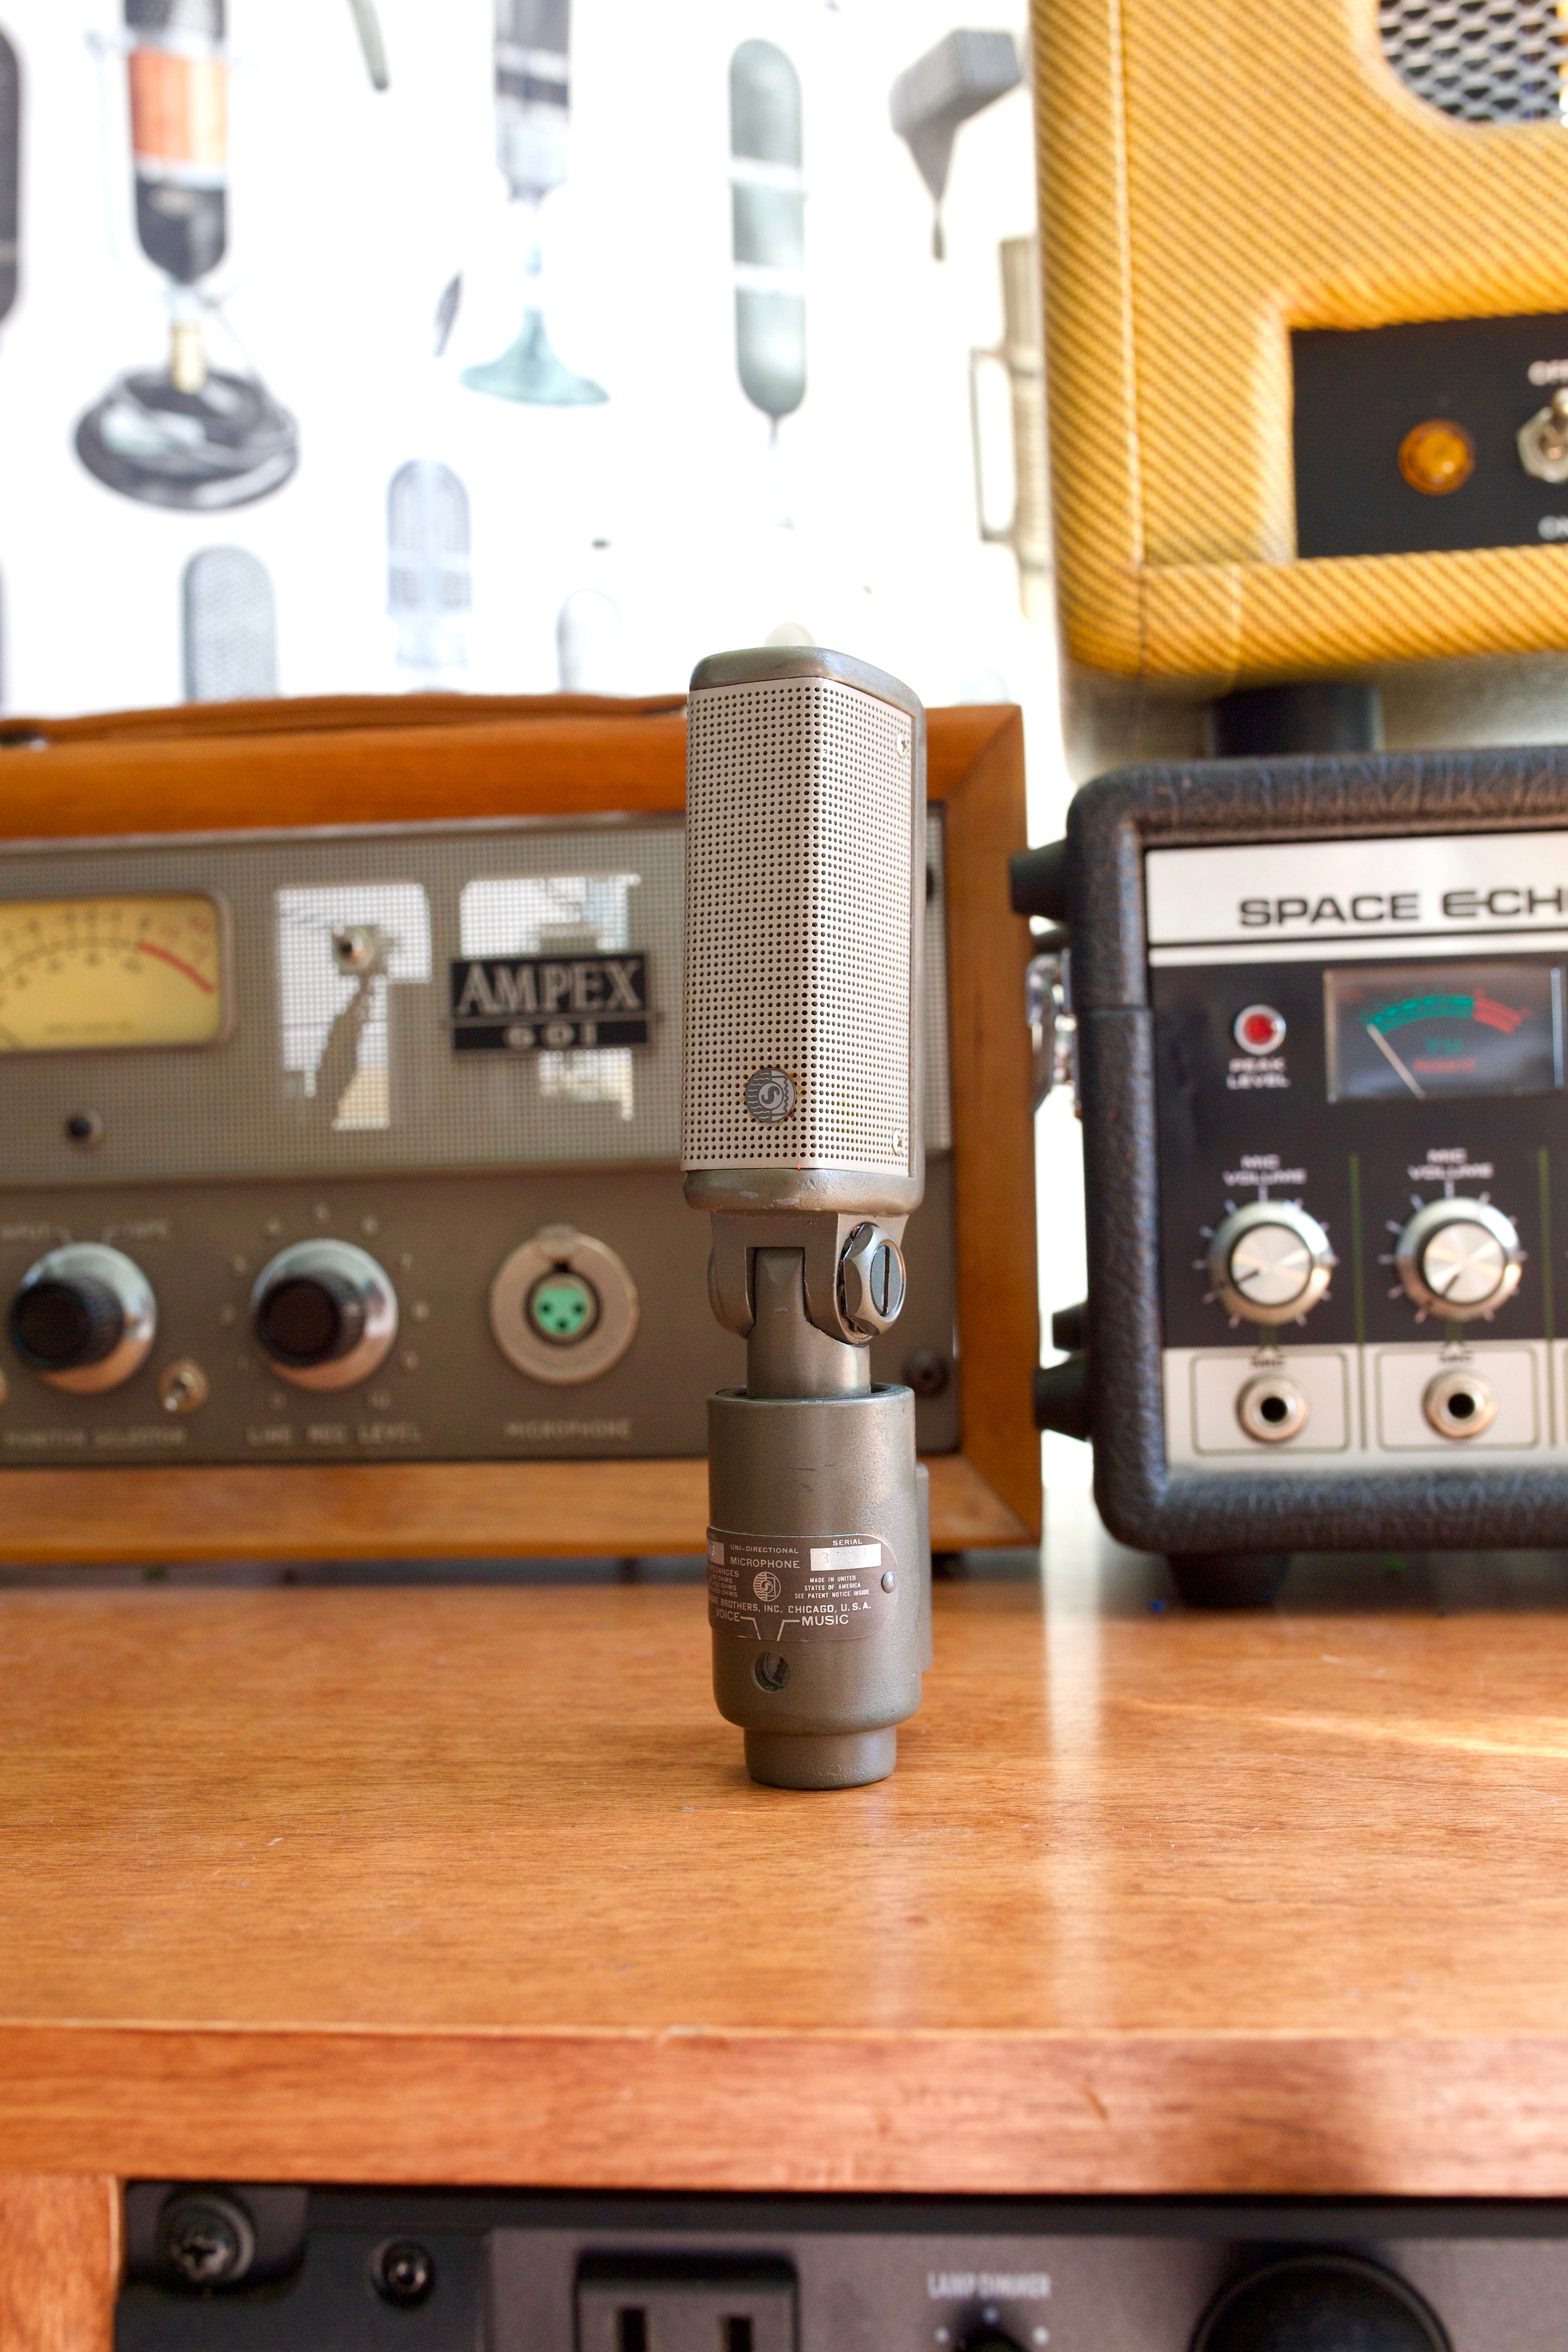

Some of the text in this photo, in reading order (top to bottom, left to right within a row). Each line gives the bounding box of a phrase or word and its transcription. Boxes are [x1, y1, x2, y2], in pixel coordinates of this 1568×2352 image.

[1240, 886, 1568, 928] SPACE ECH
[455, 959, 643, 1015] AMPEX
[1226, 1074, 1291, 1089] LEVEL
[1222, 1169, 1307, 1186] VOLUME
[1407, 1162, 1493, 1180] VOLUME
[730, 1544, 799, 1554] UNI-DIRECTIONAL
[821, 1548, 867, 1563] 3284
[730, 1557, 800, 1568] MICROPHONE
[721, 1583, 737, 1591] OHMS
[721, 1589, 738, 1597] OHMS
[721, 1598, 760, 1613] BROTHERS,
[764, 1604, 782, 1613] INC.
[788, 1604, 837, 1614] CHICAGO,
[716, 1607, 740, 1622] VOICE
[802, 1614, 849, 1626] MUSIC
